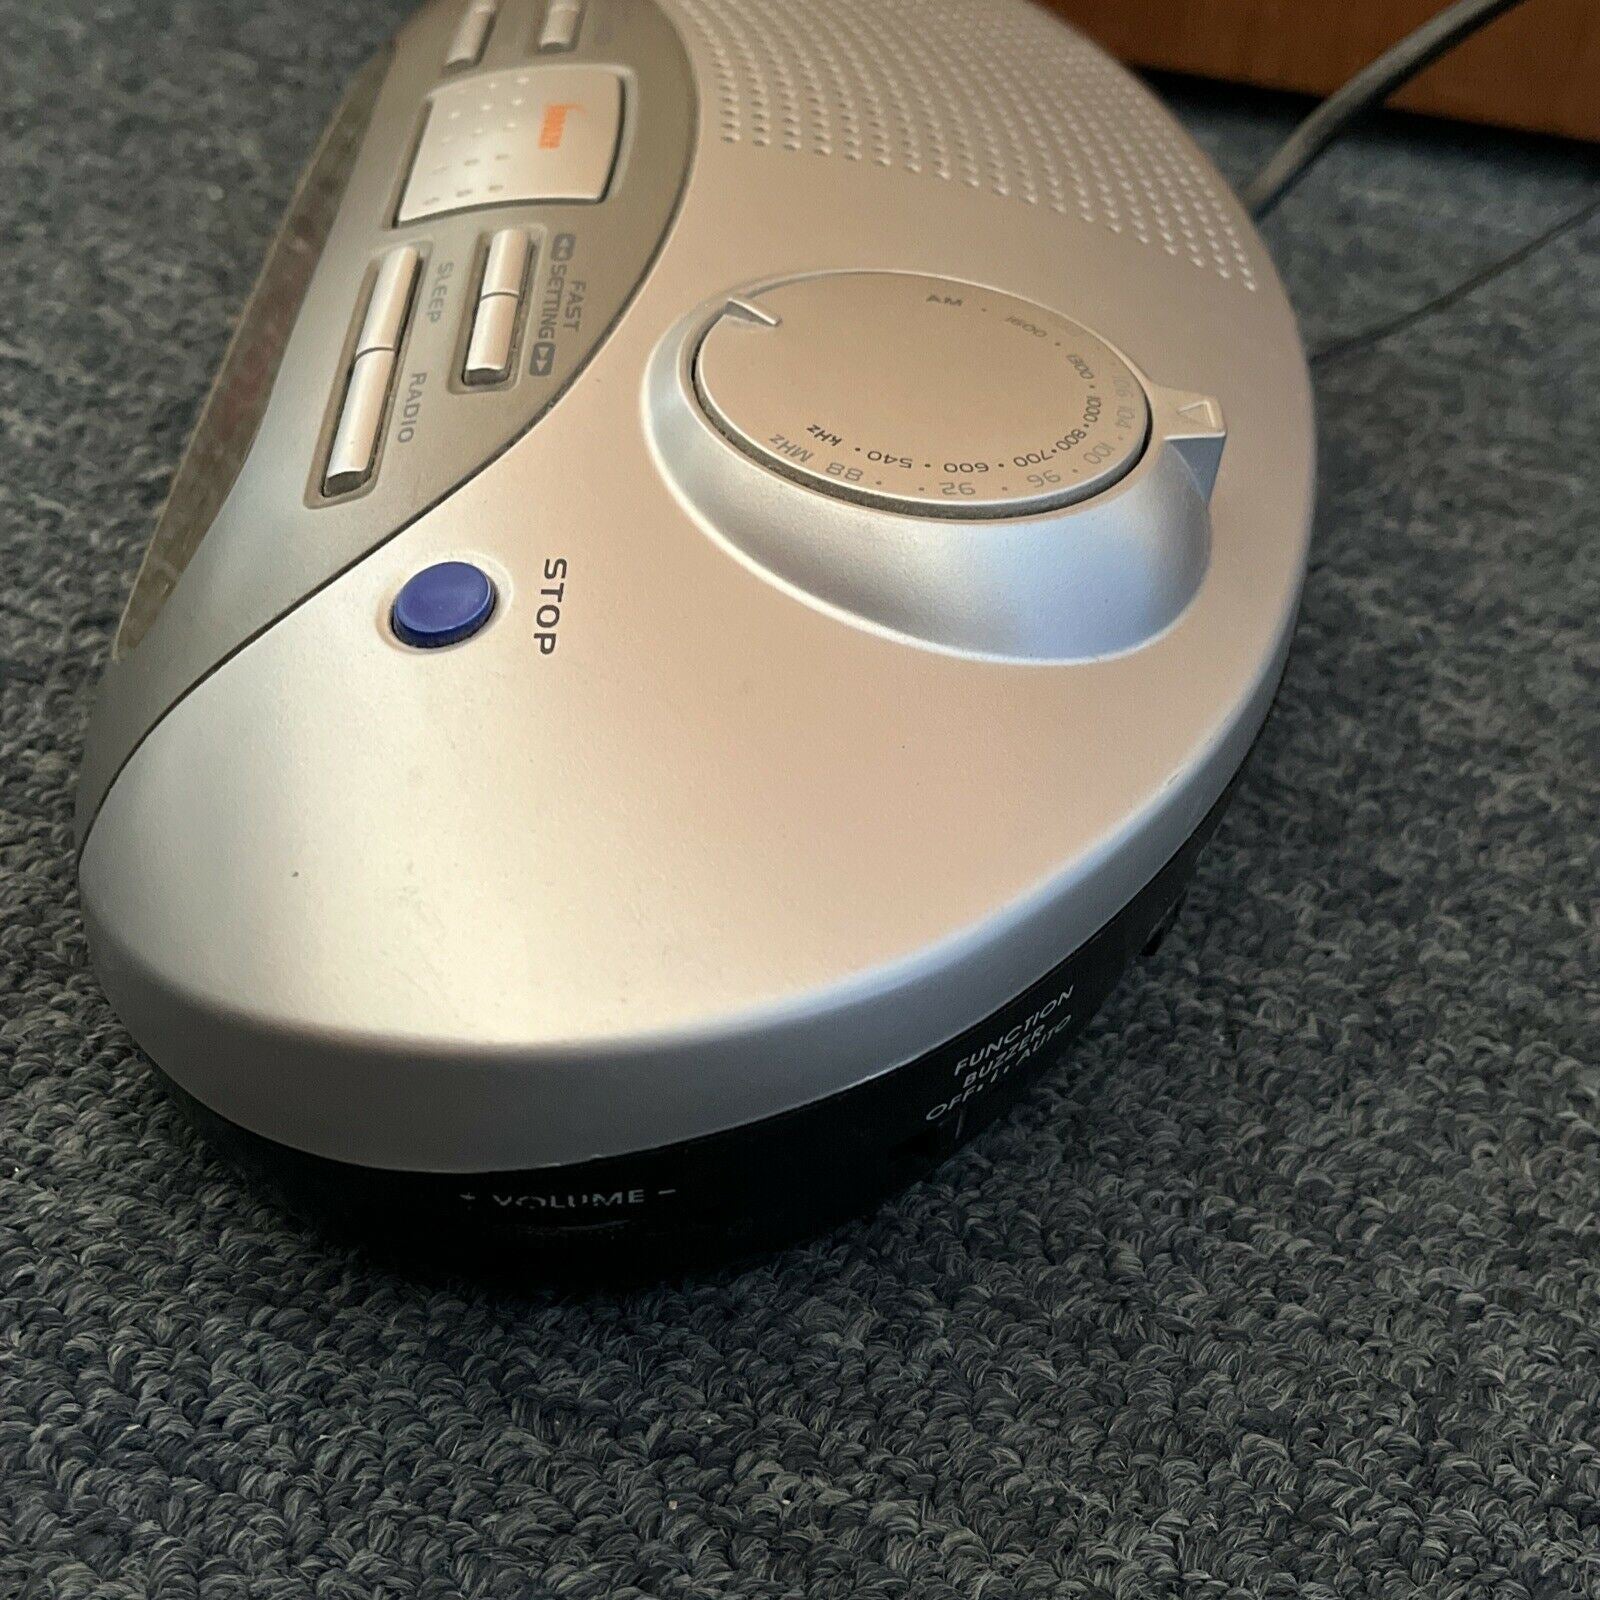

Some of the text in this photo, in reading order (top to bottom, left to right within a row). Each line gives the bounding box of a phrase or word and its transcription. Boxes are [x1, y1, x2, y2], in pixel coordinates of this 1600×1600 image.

[426, 261, 455, 324] SLEEP
[538, 264, 567, 340] SETTING
[562, 279, 587, 333] FAST
[397, 371, 428, 444] RADIO
[1083, 395, 1103, 424] 1000
[768, 432, 815, 464] MHz
[806, 423, 844, 448] kHz
[1055, 427, 1087, 452] 800
[866, 449, 914, 470] 540
[1012, 448, 1055, 469] 700
[1082, 440, 1117, 466] 100
[824, 461, 865, 483] 88
[942, 460, 990, 475] 600
[1025, 468, 1062, 489] 96
[939, 480, 977, 497] 92
[533, 558, 568, 655] STOP
[953, 984, 1074, 1076] FUNCTION
[925, 1013, 1072, 1121] OFF AUTO
[962, 1023, 1045, 1089] BUZZER
[493, 1188, 645, 1210] VOLUME
